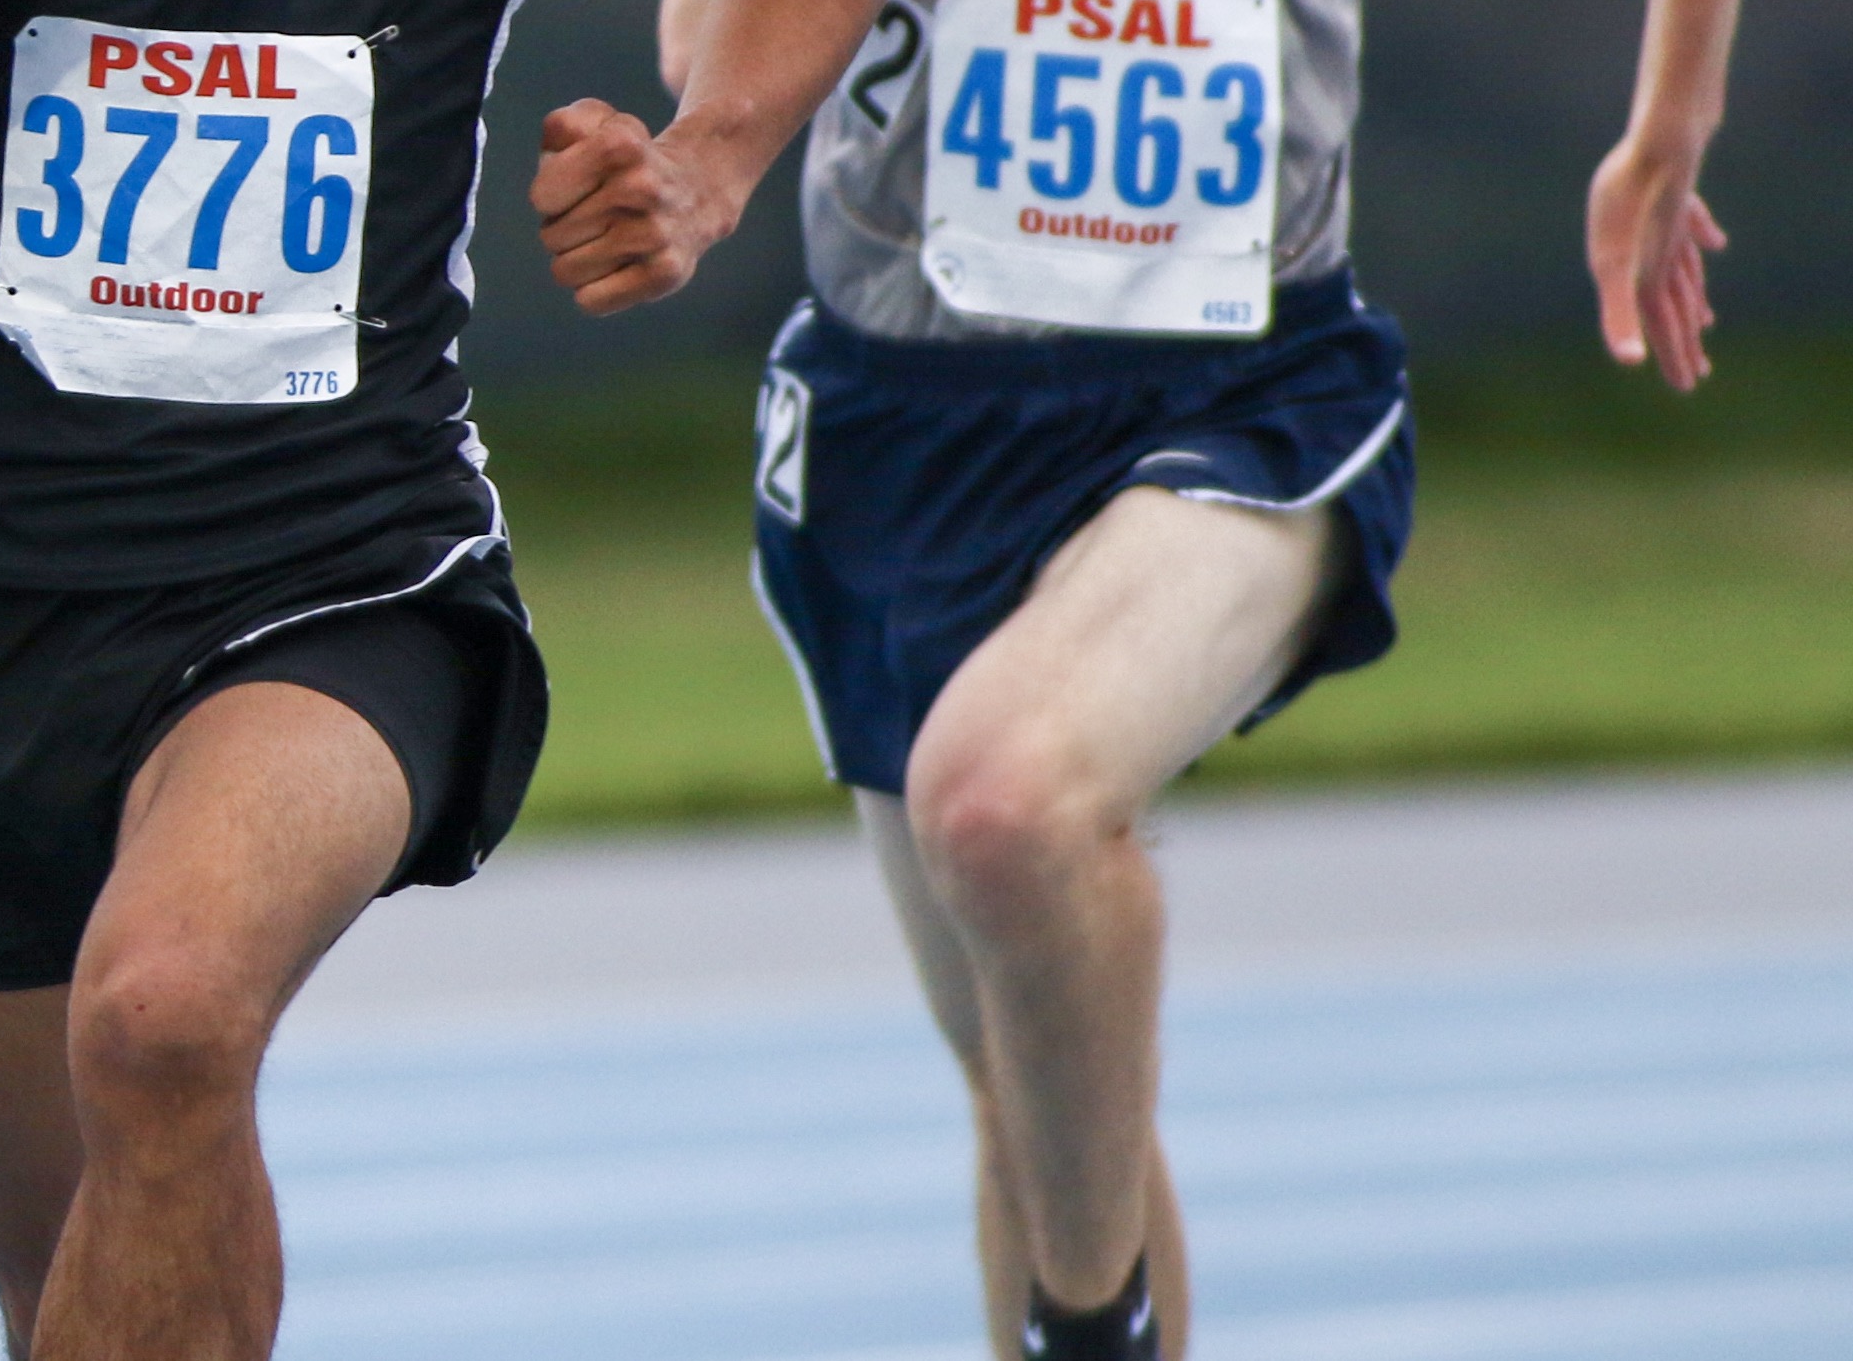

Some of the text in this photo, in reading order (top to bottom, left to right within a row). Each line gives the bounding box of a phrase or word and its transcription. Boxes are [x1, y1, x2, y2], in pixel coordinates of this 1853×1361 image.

[87, 33, 297, 100] PSAL
[941, 47, 1267, 208] 4563
[16, 94, 358, 274] 3776
[1018, 206, 1179, 245] Outdoor
[90, 275, 265, 315] Outdoor
[285, 370, 339, 397] 3776
[763, 385, 798, 513] 2
